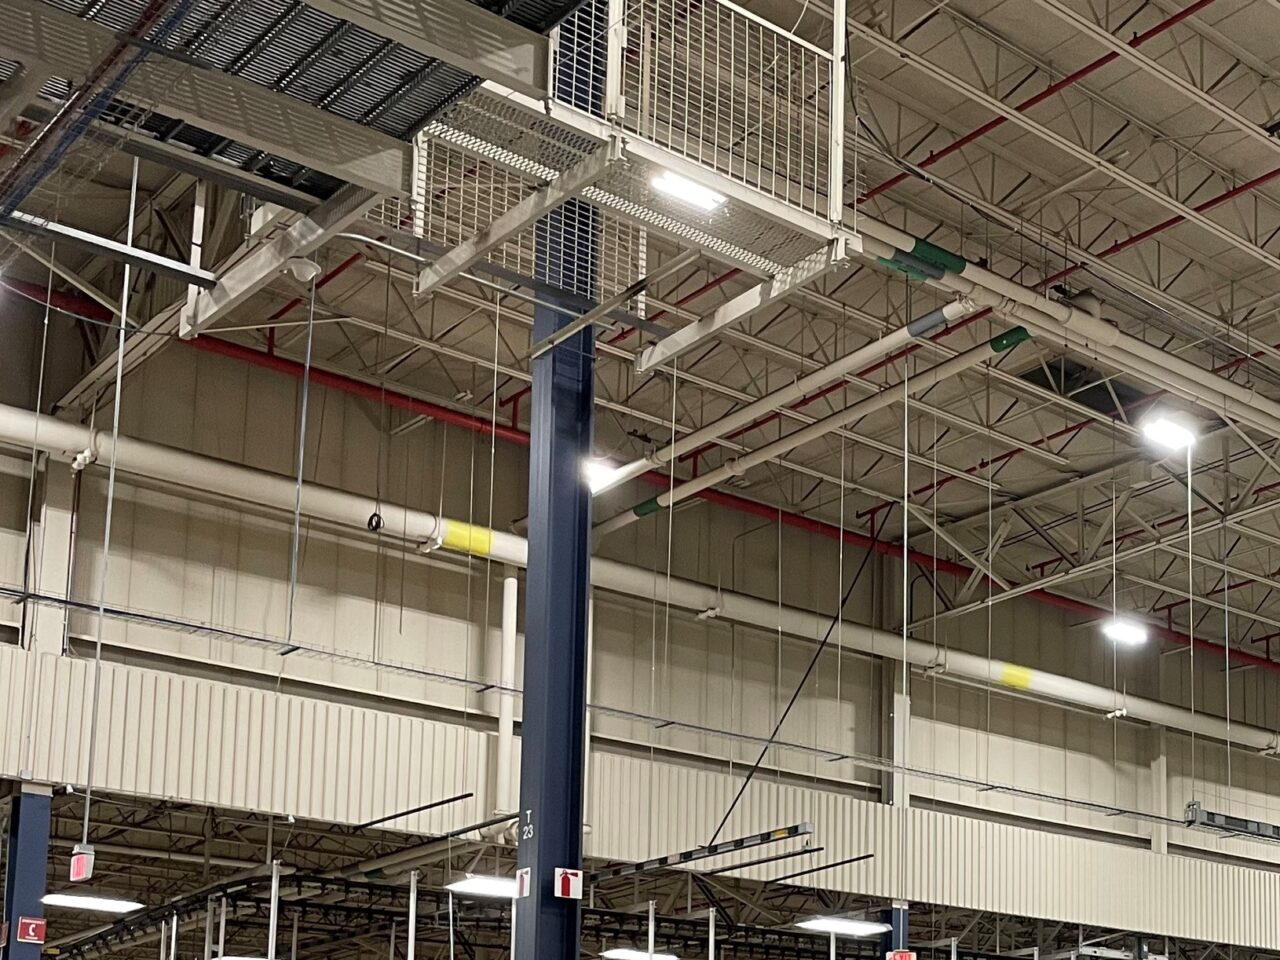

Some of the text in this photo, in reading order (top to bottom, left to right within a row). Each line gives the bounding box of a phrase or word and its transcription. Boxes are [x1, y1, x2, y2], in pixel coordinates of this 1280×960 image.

[525, 810, 532, 823] T
[523, 824, 533, 839] 23
[29, 924, 36, 936] C
